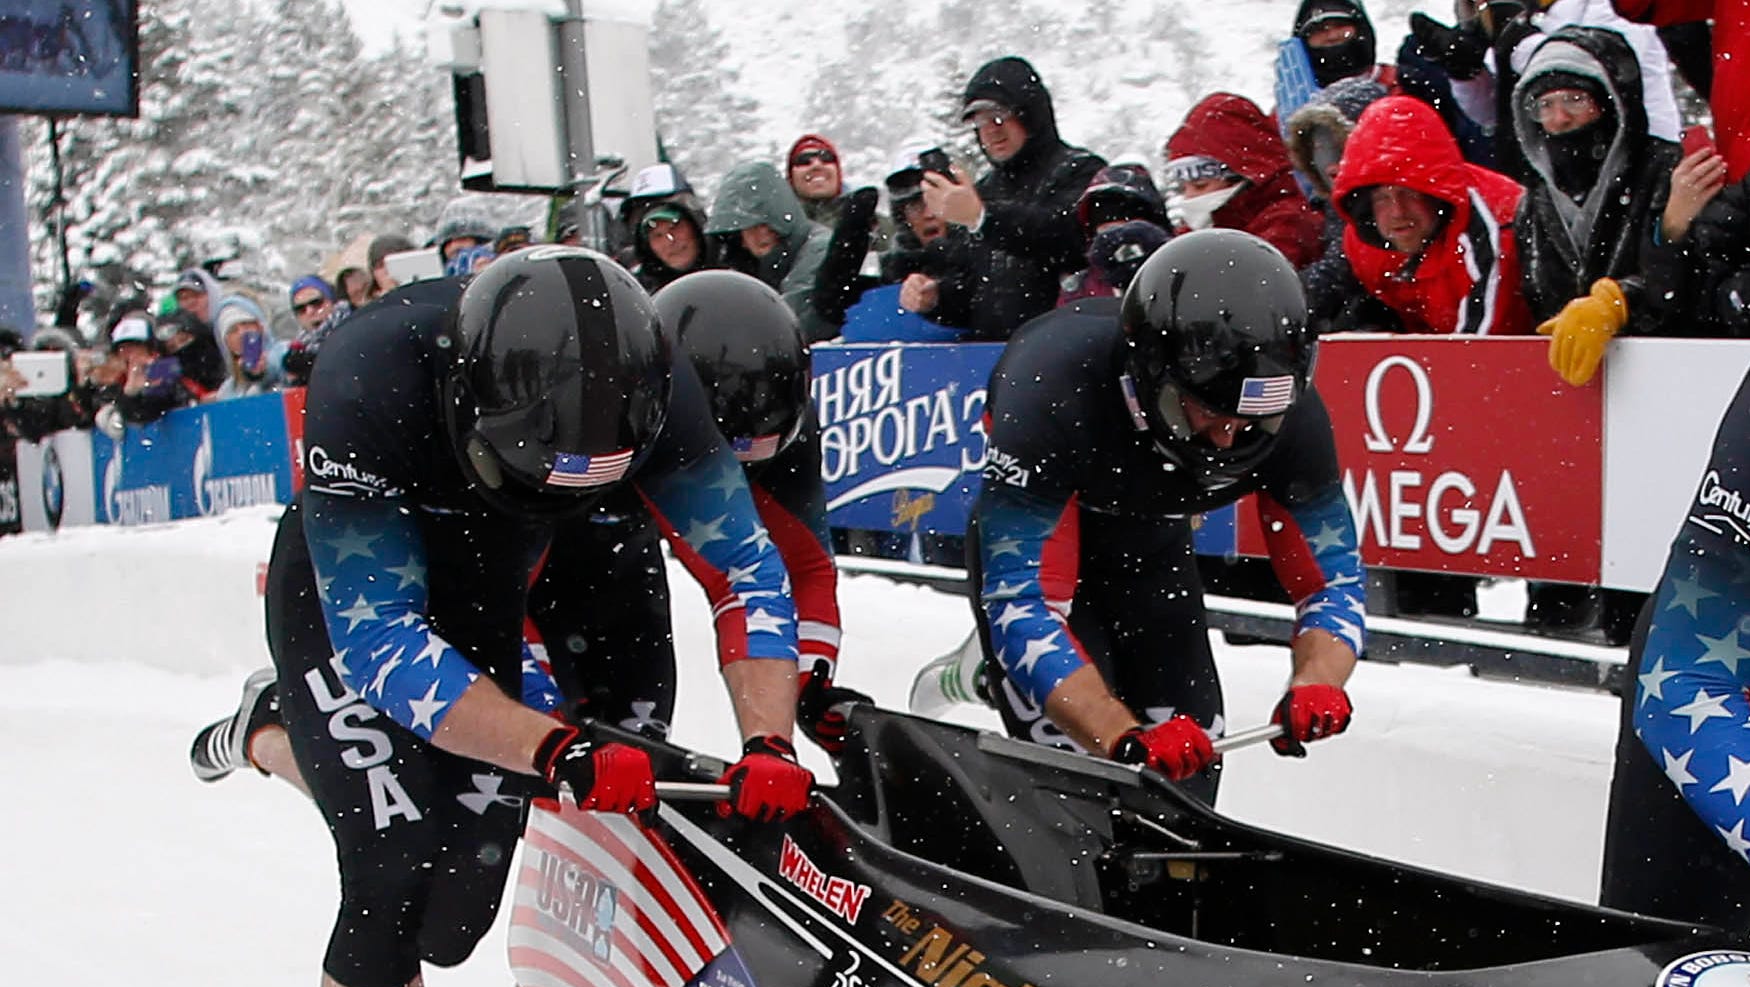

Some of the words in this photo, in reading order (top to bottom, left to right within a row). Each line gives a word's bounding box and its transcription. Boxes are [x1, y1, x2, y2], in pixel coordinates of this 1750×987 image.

[811, 349, 902, 428] НЯЯ
[820, 389, 958, 483] ОРОГА
[1342, 467, 1537, 559] MEGA
[304, 667, 423, 831] USA
[778, 833, 872, 926] WHELEN
